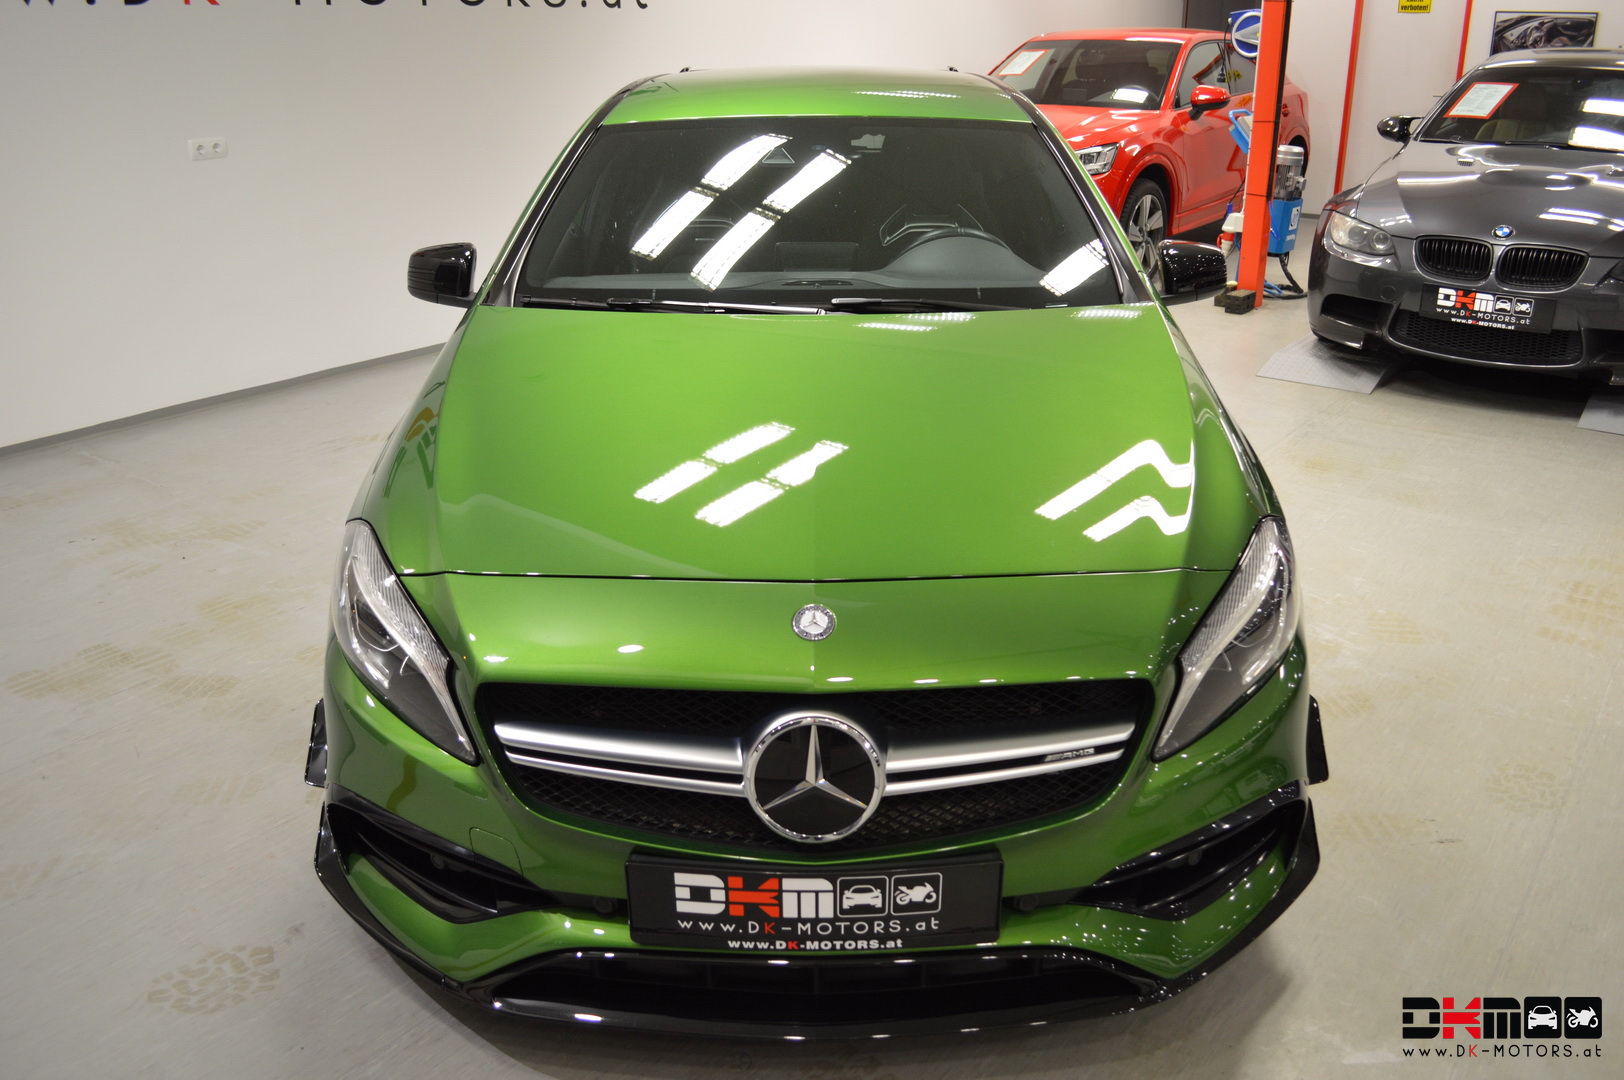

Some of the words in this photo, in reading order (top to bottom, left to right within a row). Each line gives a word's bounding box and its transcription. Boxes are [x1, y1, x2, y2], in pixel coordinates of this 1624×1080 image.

[1436, 307, 1531, 325] www.DK-MOTORS.at
[1451, 317, 1515, 330] www.DK-MOTORS.at
[1060, 747, 1095, 759] AMG
[674, 872, 834, 918] DKM
[677, 917, 940, 935] www.DK-MOTORS.at
[728, 939, 903, 950] www.DK-MOTORS.at
